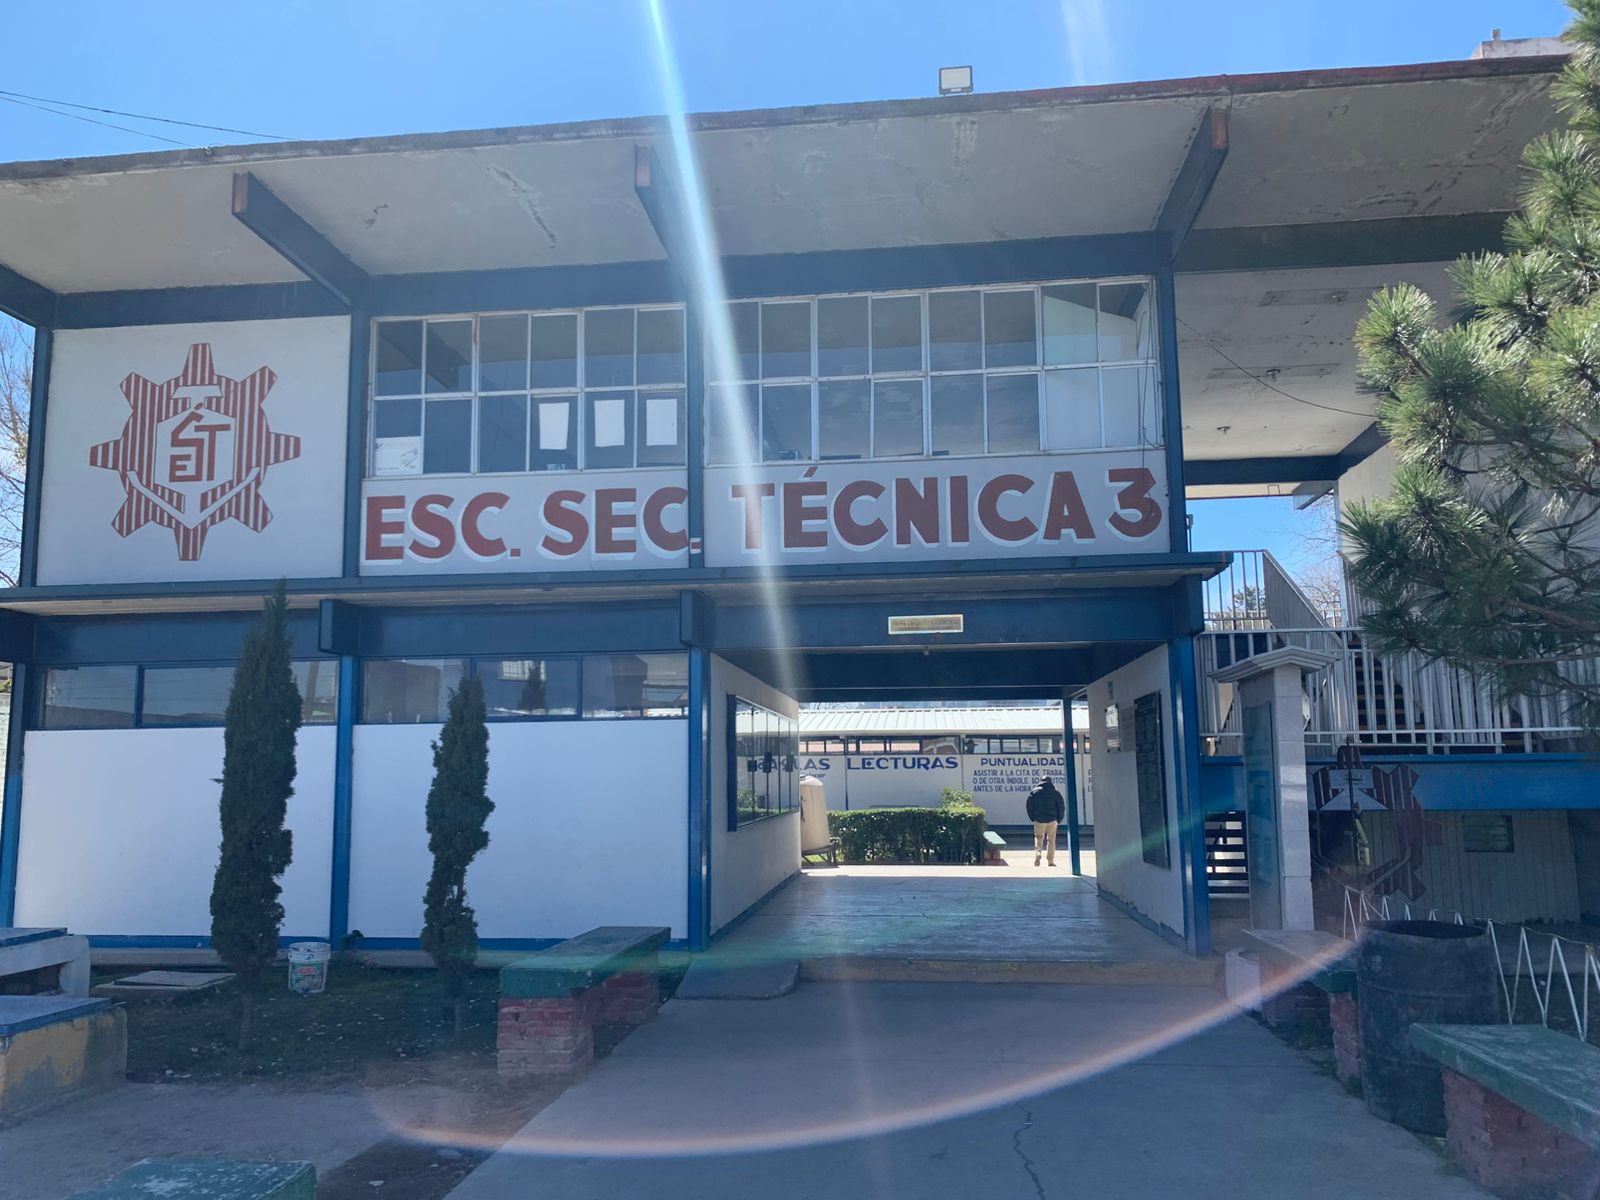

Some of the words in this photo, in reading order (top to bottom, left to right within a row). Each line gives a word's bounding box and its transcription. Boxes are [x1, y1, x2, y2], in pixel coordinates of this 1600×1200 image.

[365, 491, 522, 562] ESC.
[540, 487, 702, 558] SEC.
[731, 467, 1097, 551] TÉCNICA
[1106, 467, 1164, 538] 3
[800, 757, 831, 771] AS
[847, 756, 958, 770] LECTURAS
[980, 757, 1065, 767] PUNTUALIDAD
[1015, 769, 1031, 777] CITA
[1032, 769, 1040, 777] DE
[979, 777, 988, 785] DE
[988, 777, 1006, 785] OTRA
[973, 784, 994, 792] ANTES
[994, 784, 1004, 792] DE
[1005, 784, 1014, 792] LA
